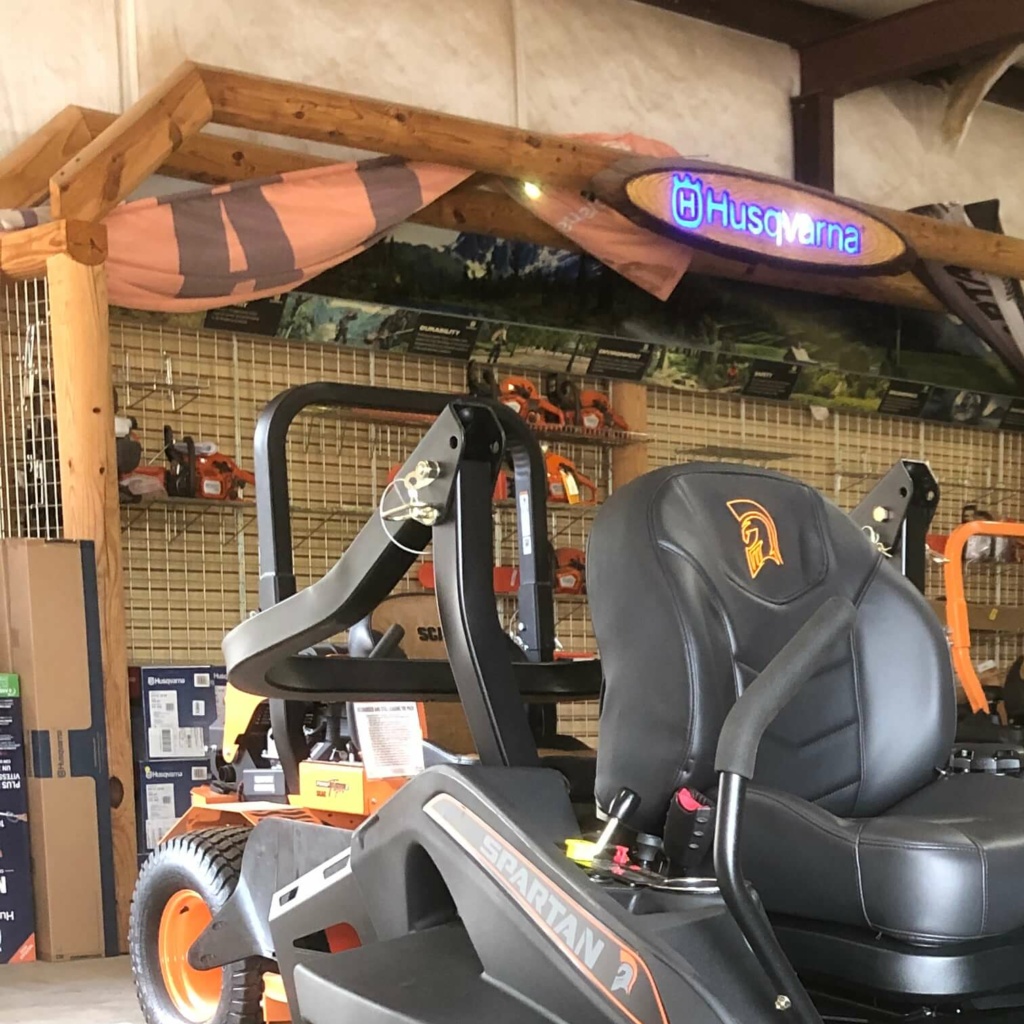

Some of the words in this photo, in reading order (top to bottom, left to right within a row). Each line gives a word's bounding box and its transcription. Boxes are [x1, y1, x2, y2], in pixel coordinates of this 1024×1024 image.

[706, 187, 862, 254] Husqvarna
[418, 323, 461, 337] DURABILITY
[154, 677, 186, 686] Husqvarna
[152, 770, 183, 779] Husqvarna
[479, 835, 605, 969] SPARTAN
